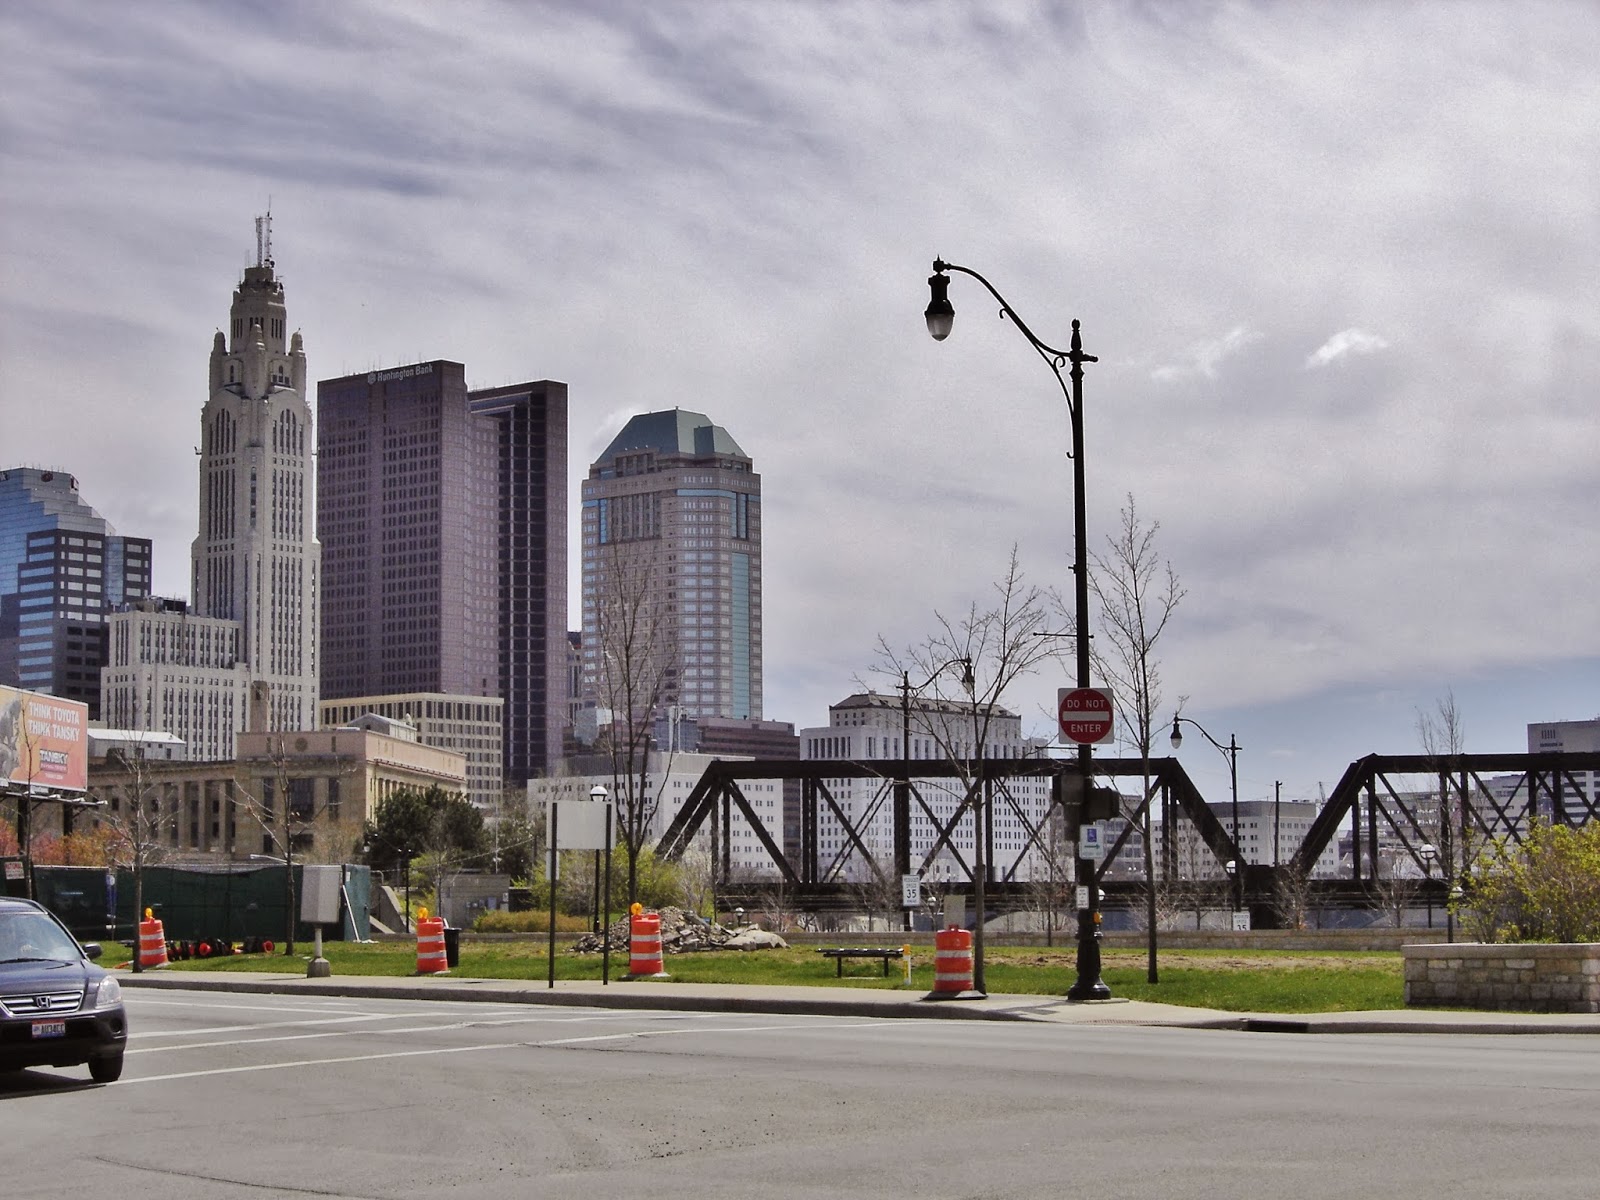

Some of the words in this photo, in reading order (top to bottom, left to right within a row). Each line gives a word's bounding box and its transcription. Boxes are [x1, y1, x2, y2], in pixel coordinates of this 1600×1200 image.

[377, 369, 414, 381] Huntington
[416, 364, 433, 375] Bank
[1067, 699, 1080, 708] DO
[1085, 699, 1105, 708] NOT
[29, 702, 51, 720] THINK
[53, 706, 80, 725] TOYOTA
[29, 720, 51, 737] THINK
[52, 724, 80, 741] TANSKY
[1071, 724, 1101, 732] ENTER
[907, 889, 917, 898] 35
